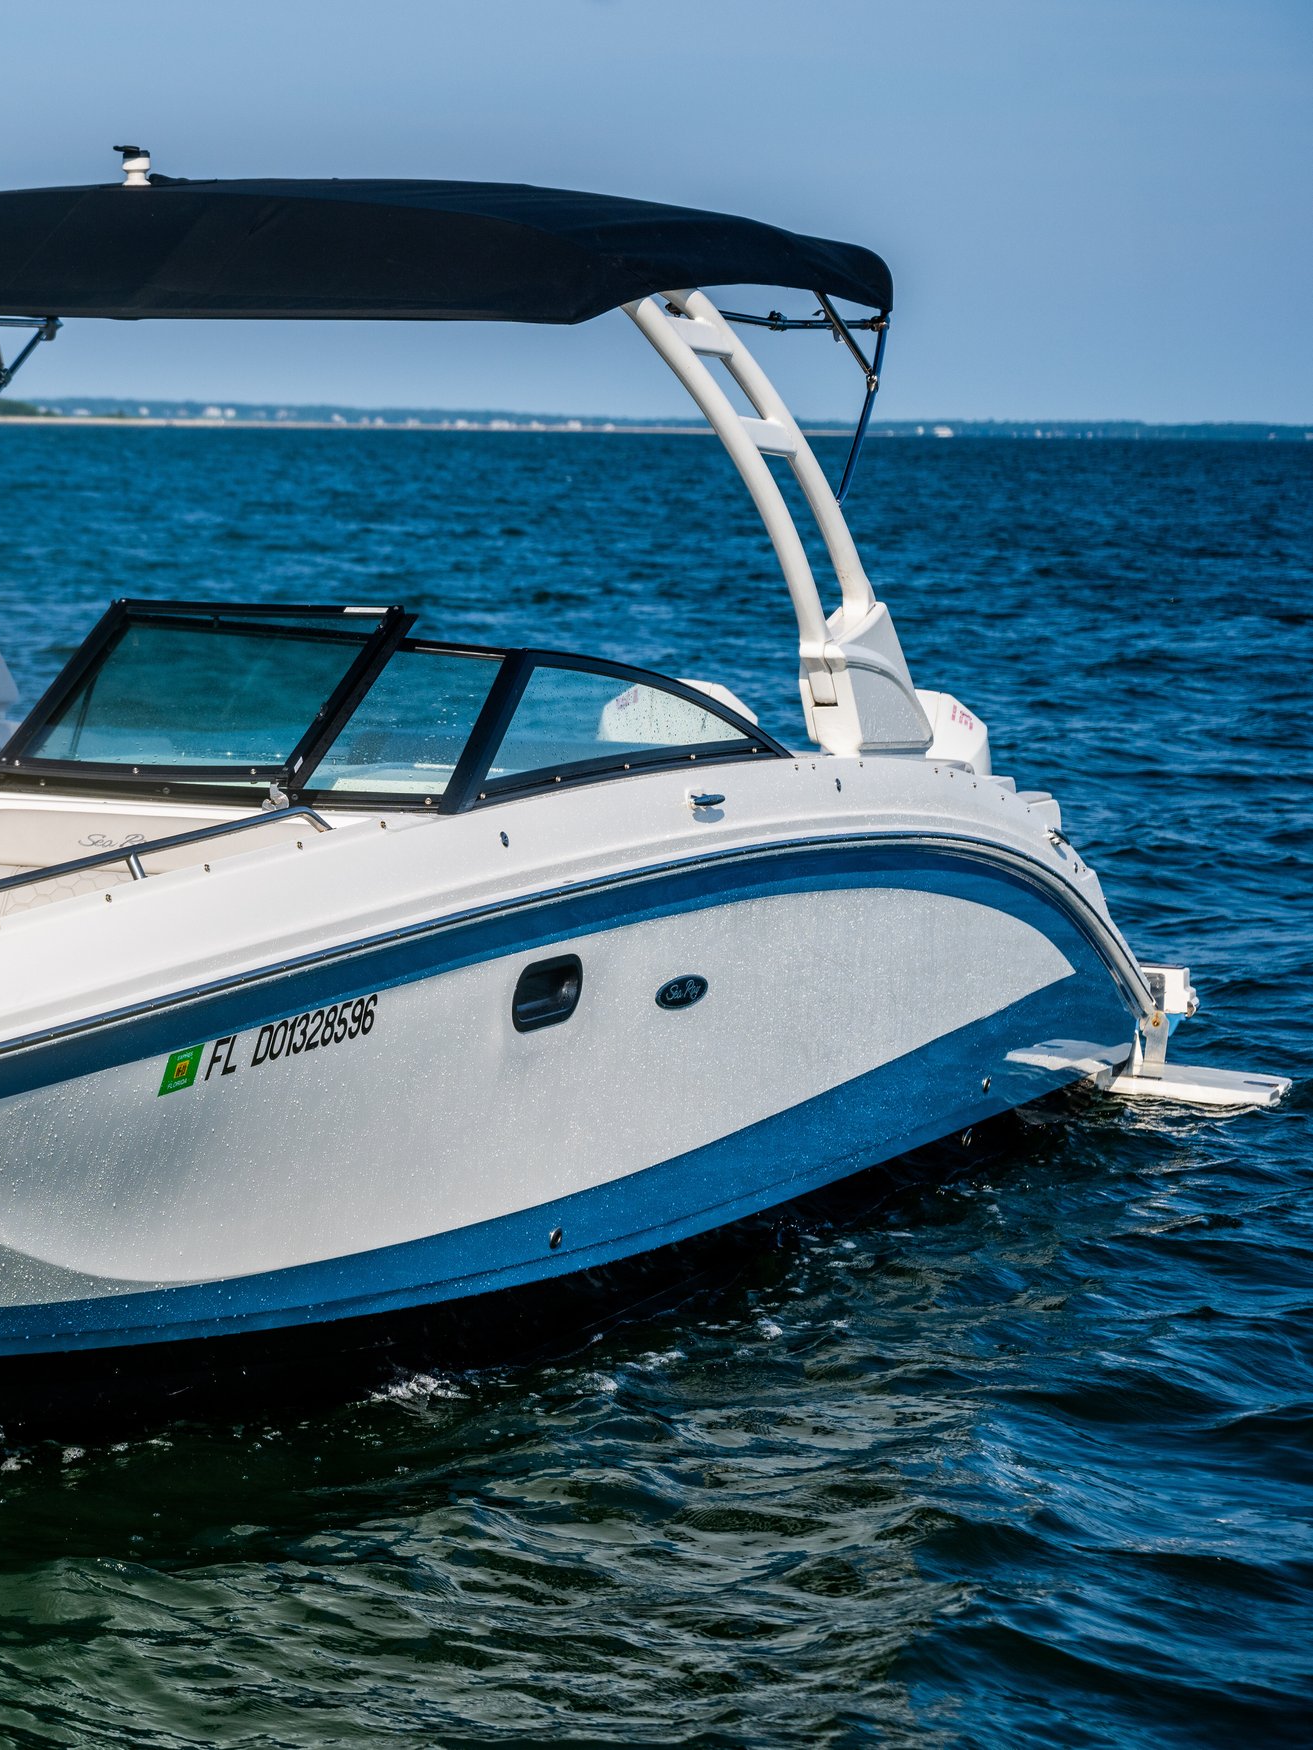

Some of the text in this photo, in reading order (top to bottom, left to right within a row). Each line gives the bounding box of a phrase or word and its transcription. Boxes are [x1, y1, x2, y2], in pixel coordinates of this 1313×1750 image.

[78, 834, 117, 848] Sea
[666, 984, 683, 1000] Sea
[204, 1035, 237, 1081] FL
